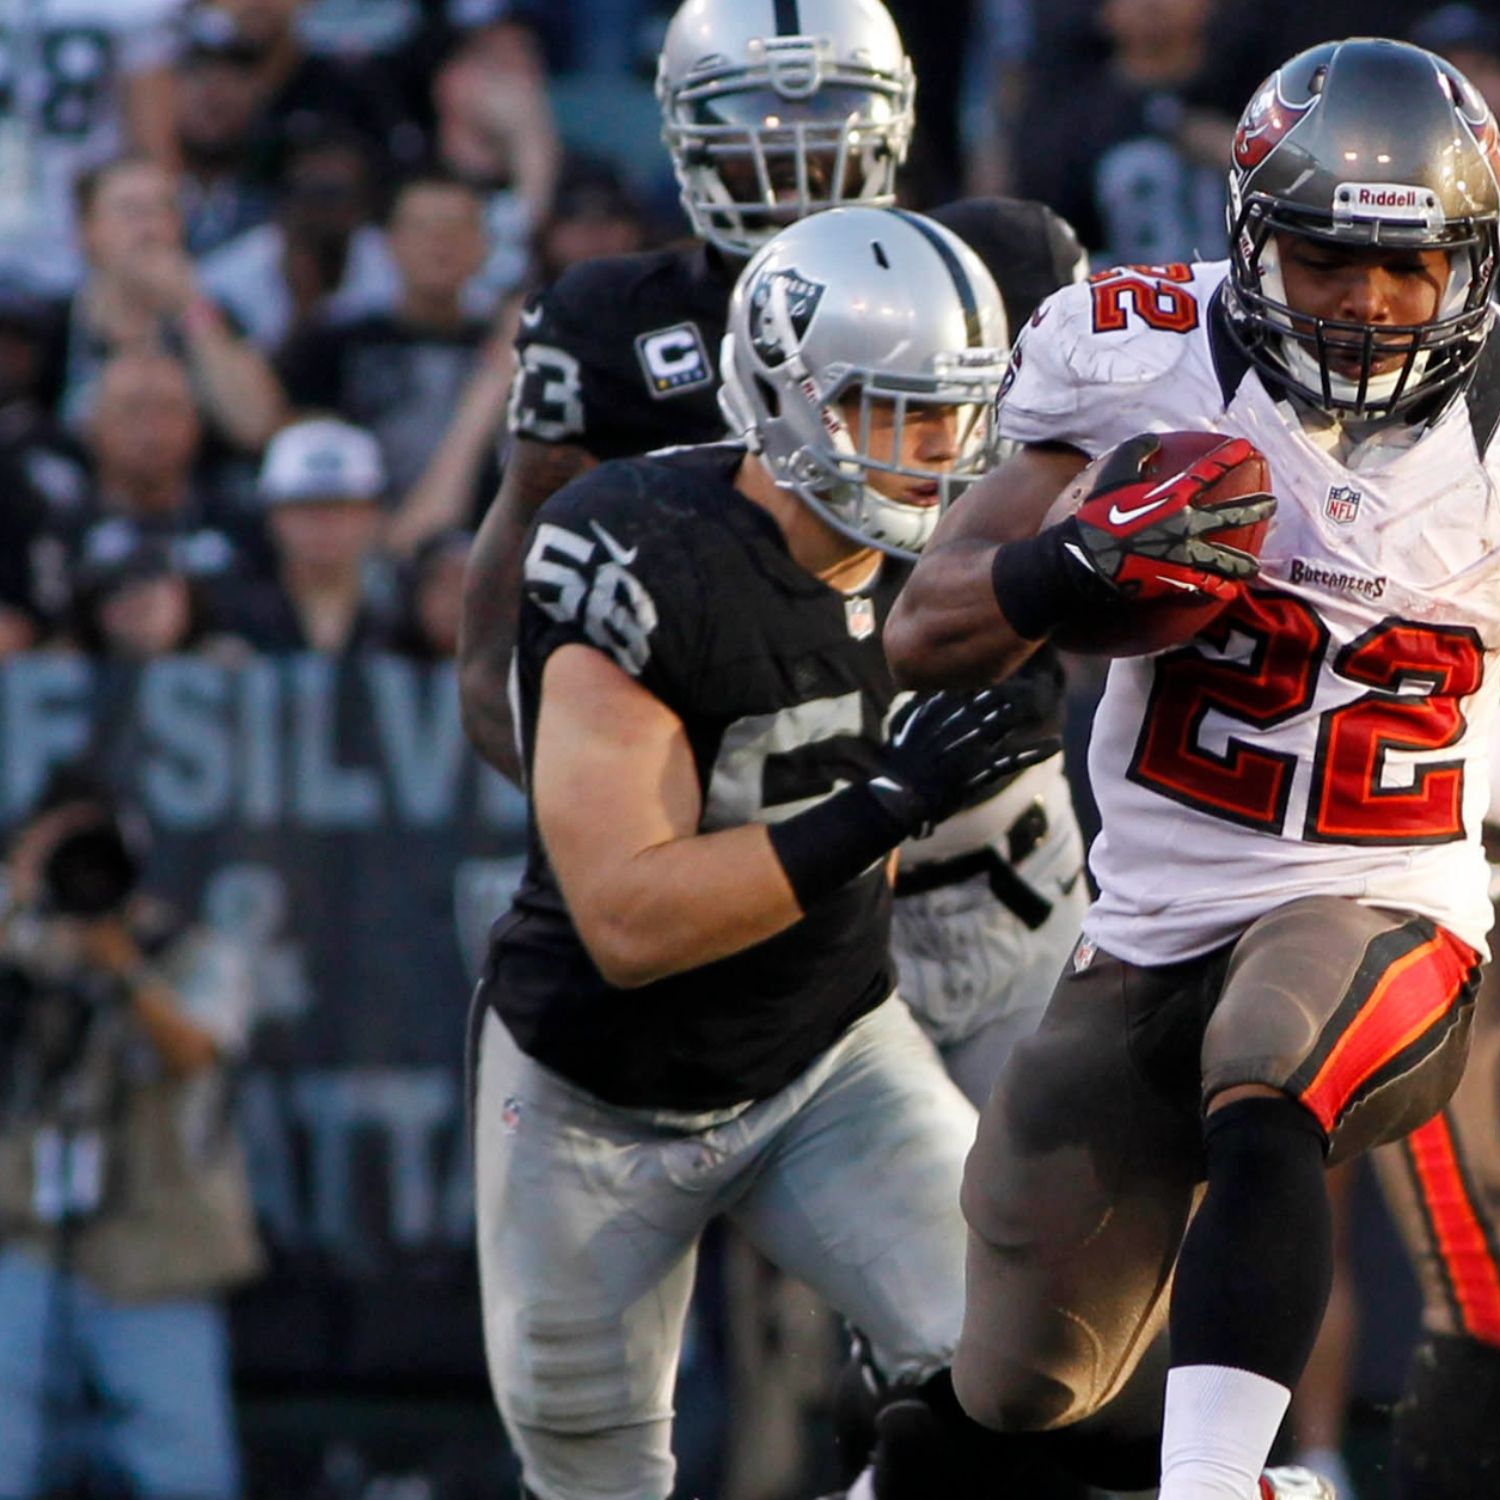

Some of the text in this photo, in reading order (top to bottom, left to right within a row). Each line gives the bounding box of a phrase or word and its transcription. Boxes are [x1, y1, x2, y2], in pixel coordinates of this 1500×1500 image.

[1359, 189, 1416, 207] Riddell
[645, 330, 701, 378] C
[507, 343, 585, 441] 3
[1328, 501, 1354, 521] NFL
[139, 652, 528, 832] SILV
[1126, 588, 1484, 847] 22
